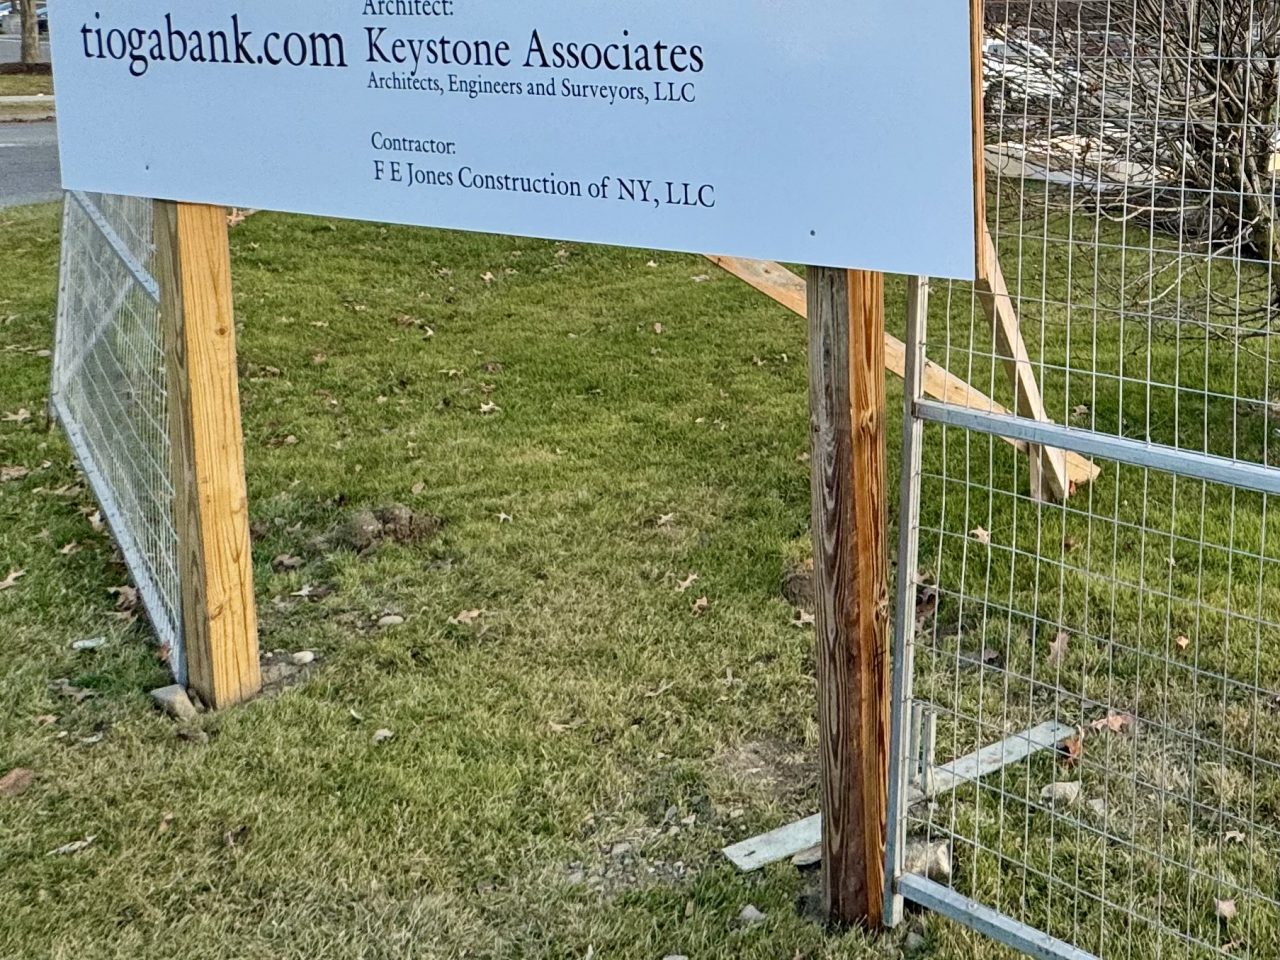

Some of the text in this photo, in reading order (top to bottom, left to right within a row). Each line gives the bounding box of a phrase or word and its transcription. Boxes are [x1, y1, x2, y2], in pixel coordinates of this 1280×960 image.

[80, 11, 348, 77] tiogabank.com
[363, 26, 705, 75] Keystone Associates
[367, 71, 696, 105] Architects, Engineers and Surveyors, LLC
[371, 131, 456, 155] Contractor:
[373, 159, 716, 209] F E Jones Construction of NY, LLC
